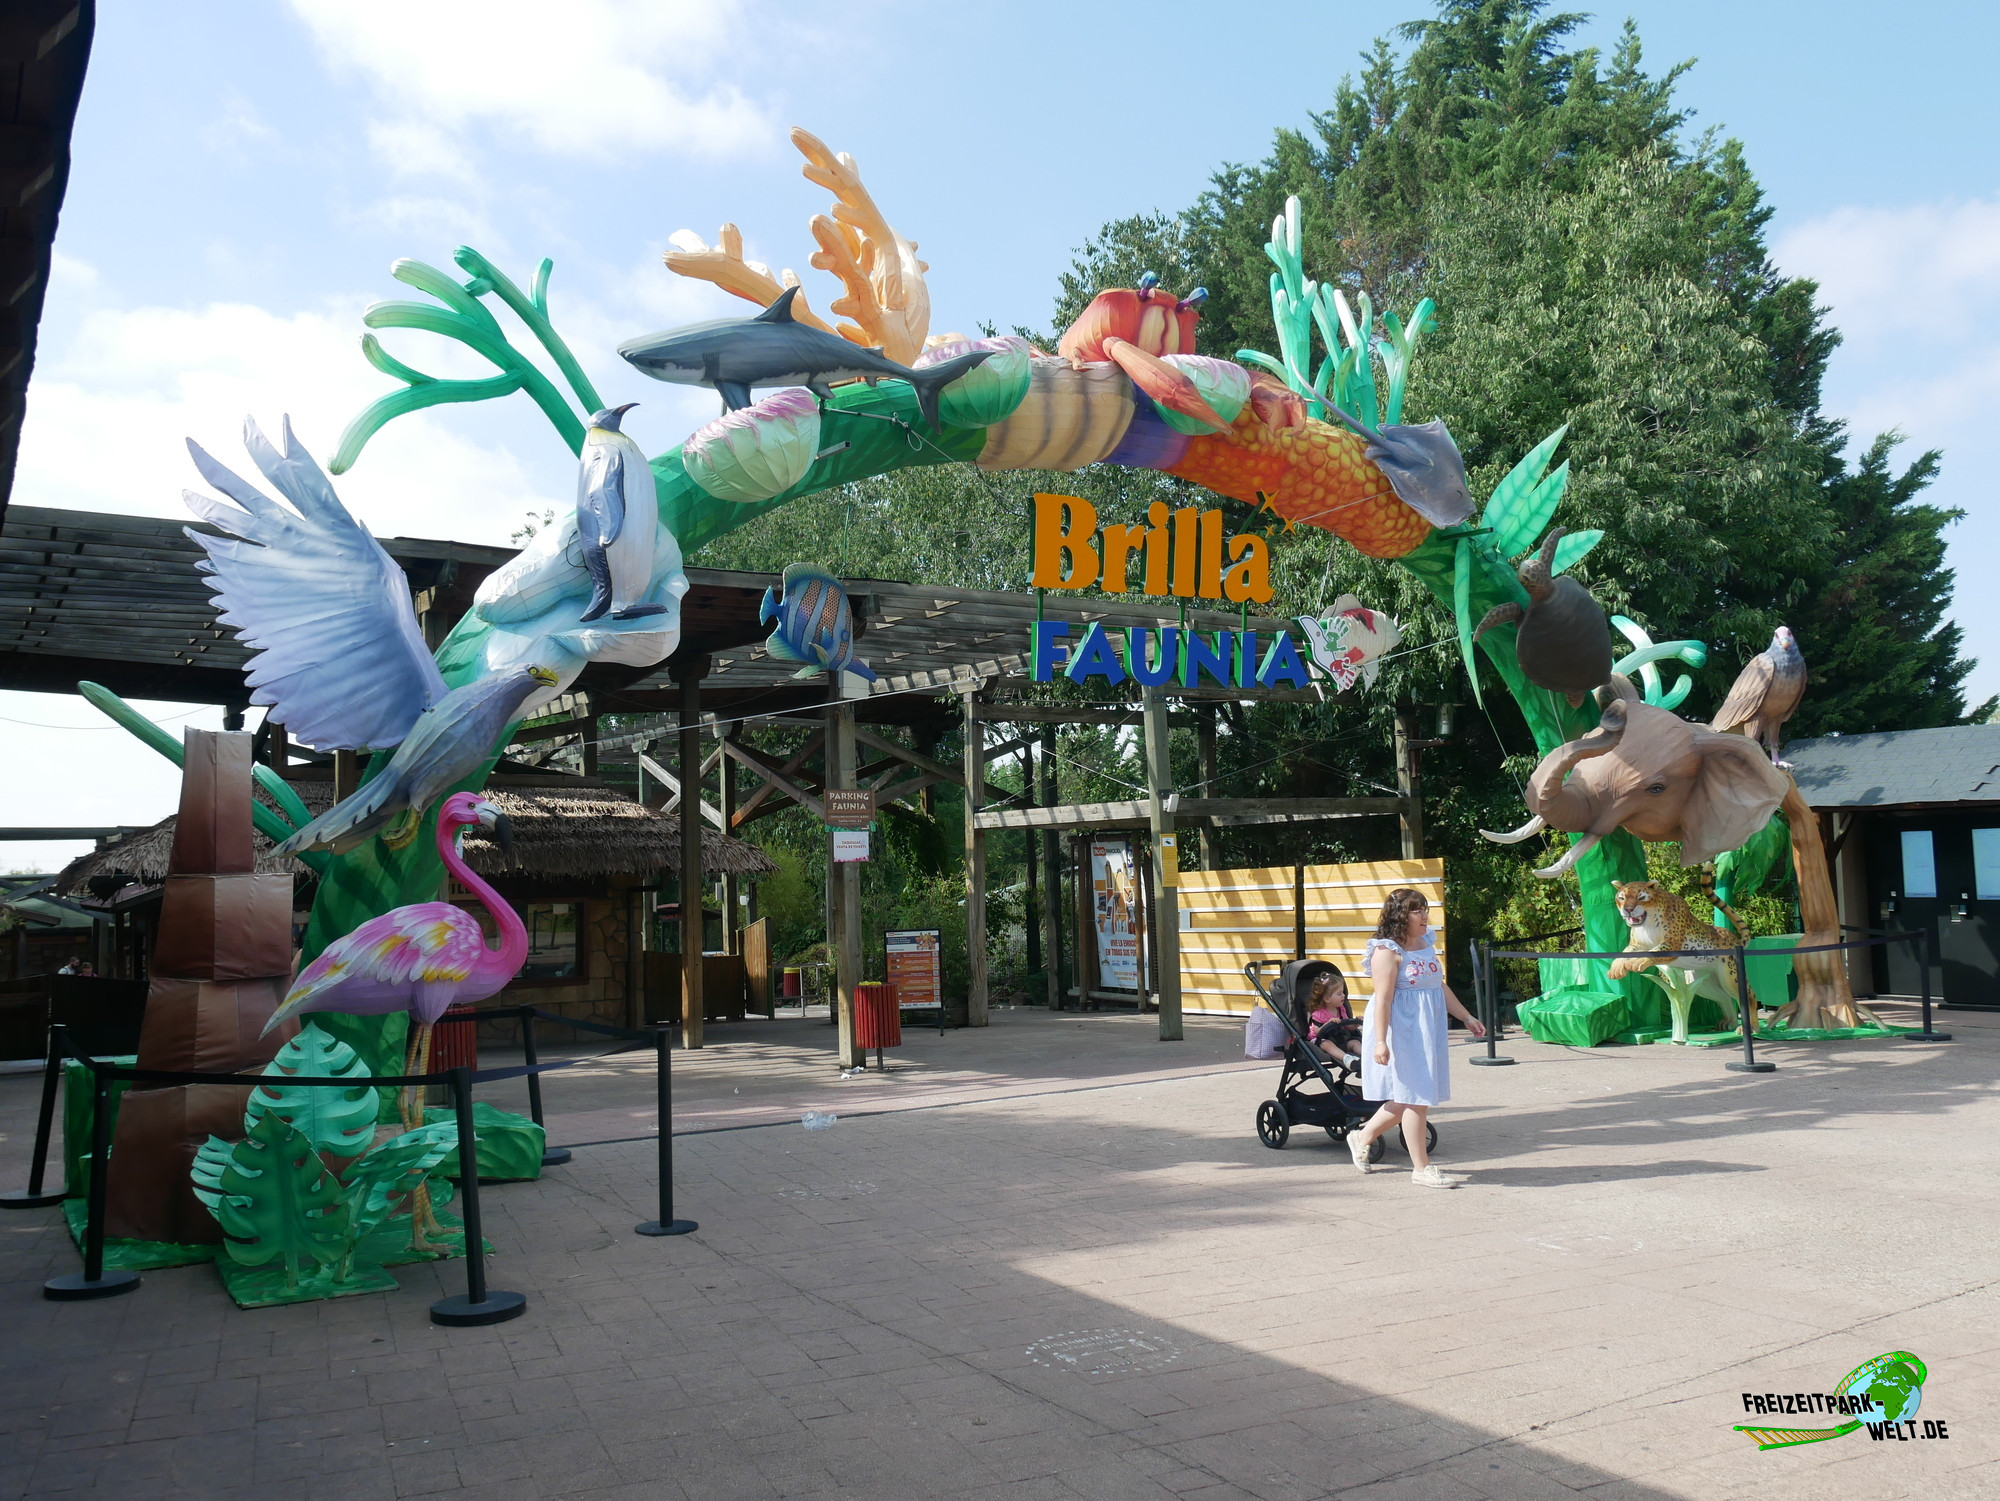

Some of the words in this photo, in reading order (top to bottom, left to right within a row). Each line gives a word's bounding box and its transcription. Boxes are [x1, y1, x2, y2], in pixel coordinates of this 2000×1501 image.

[1031, 493, 1274, 604] Brilla
[1032, 621, 1309, 690] FAUNIA
[829, 792, 869, 800] PARKING
[832, 802, 867, 810] FAUNIA
